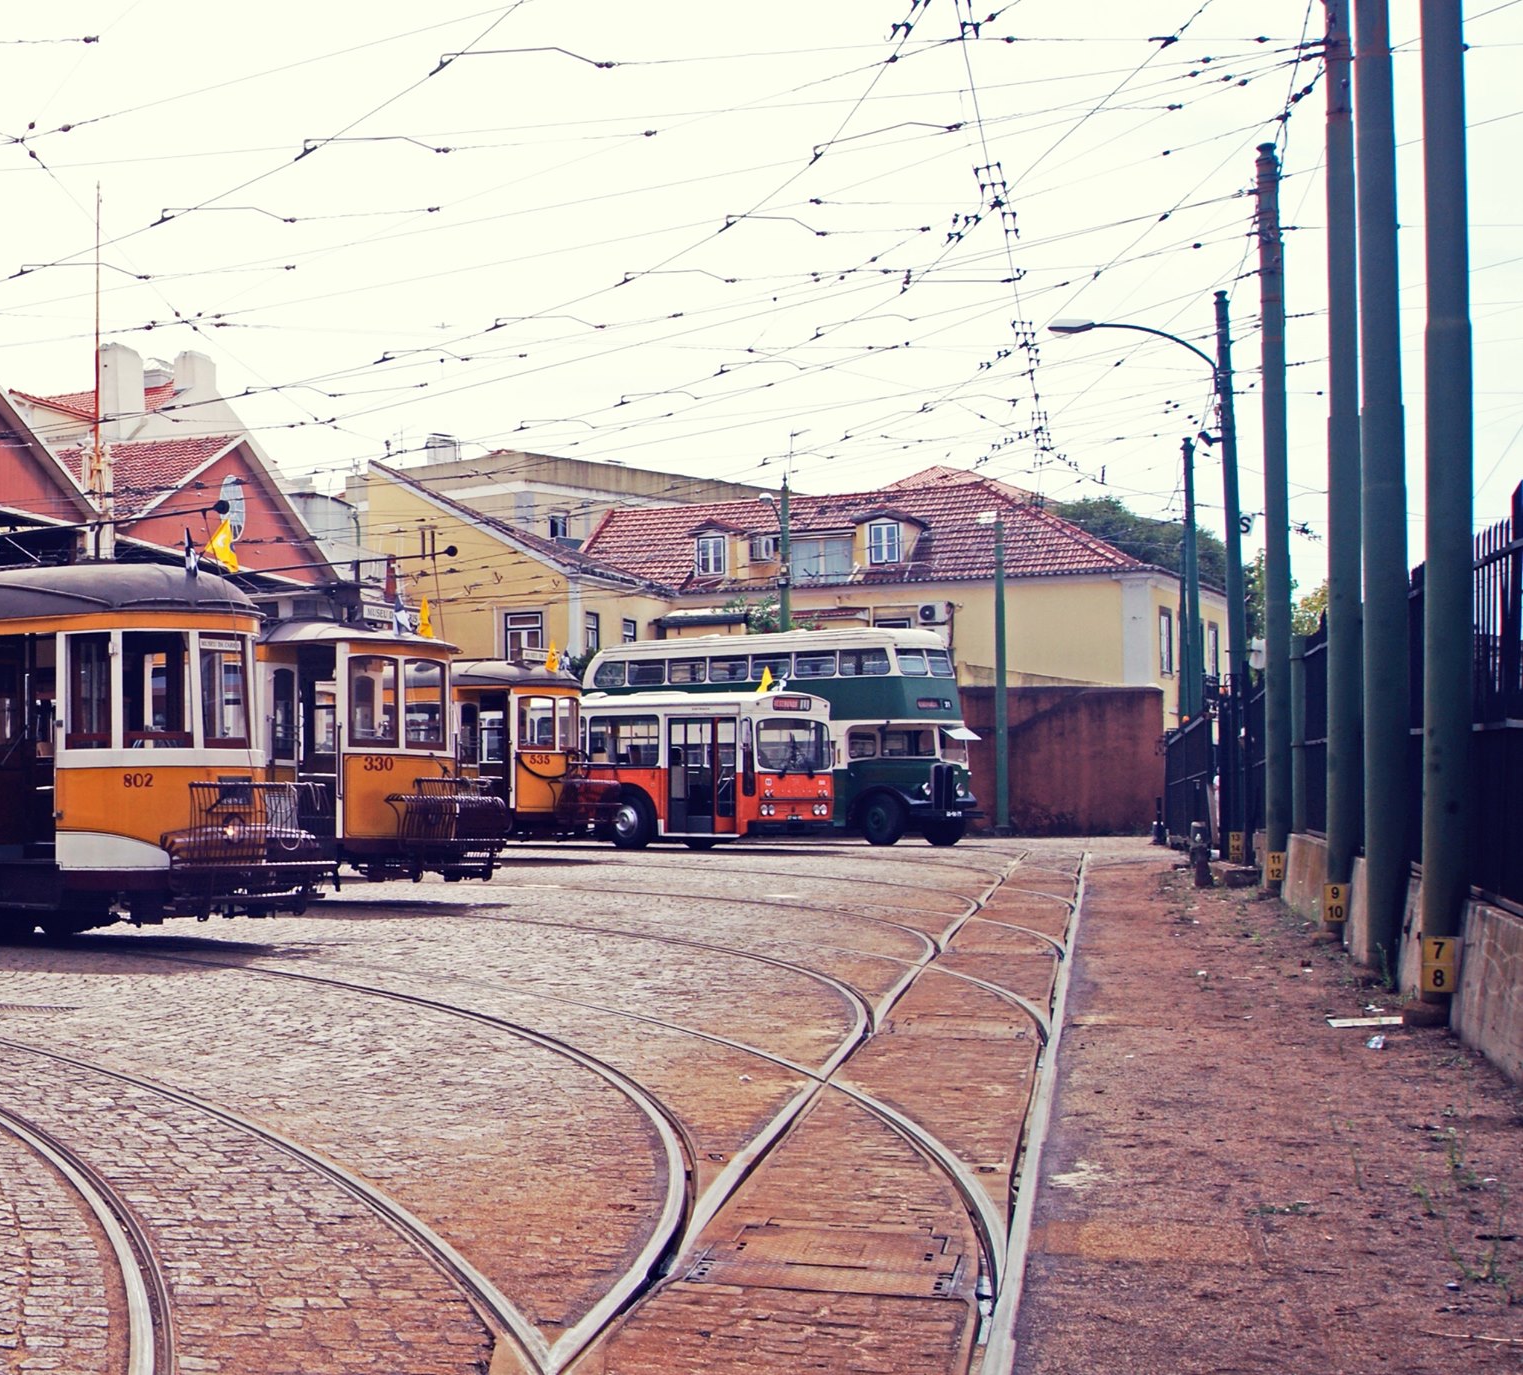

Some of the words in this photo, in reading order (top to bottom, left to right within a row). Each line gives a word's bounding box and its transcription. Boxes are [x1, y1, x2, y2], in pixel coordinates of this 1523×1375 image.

[1239, 516, 1251, 534] S
[363, 756, 394, 772] 330
[529, 754, 551, 765] 535
[123, 773, 154, 788] 802
[1270, 854, 1281, 865] 11
[1270, 868, 1282, 879] 12
[1331, 886, 1340, 899] 9
[1328, 905, 1344, 919] 10
[1432, 941, 1445, 960] 7
[1432, 969, 1445, 988] 8
